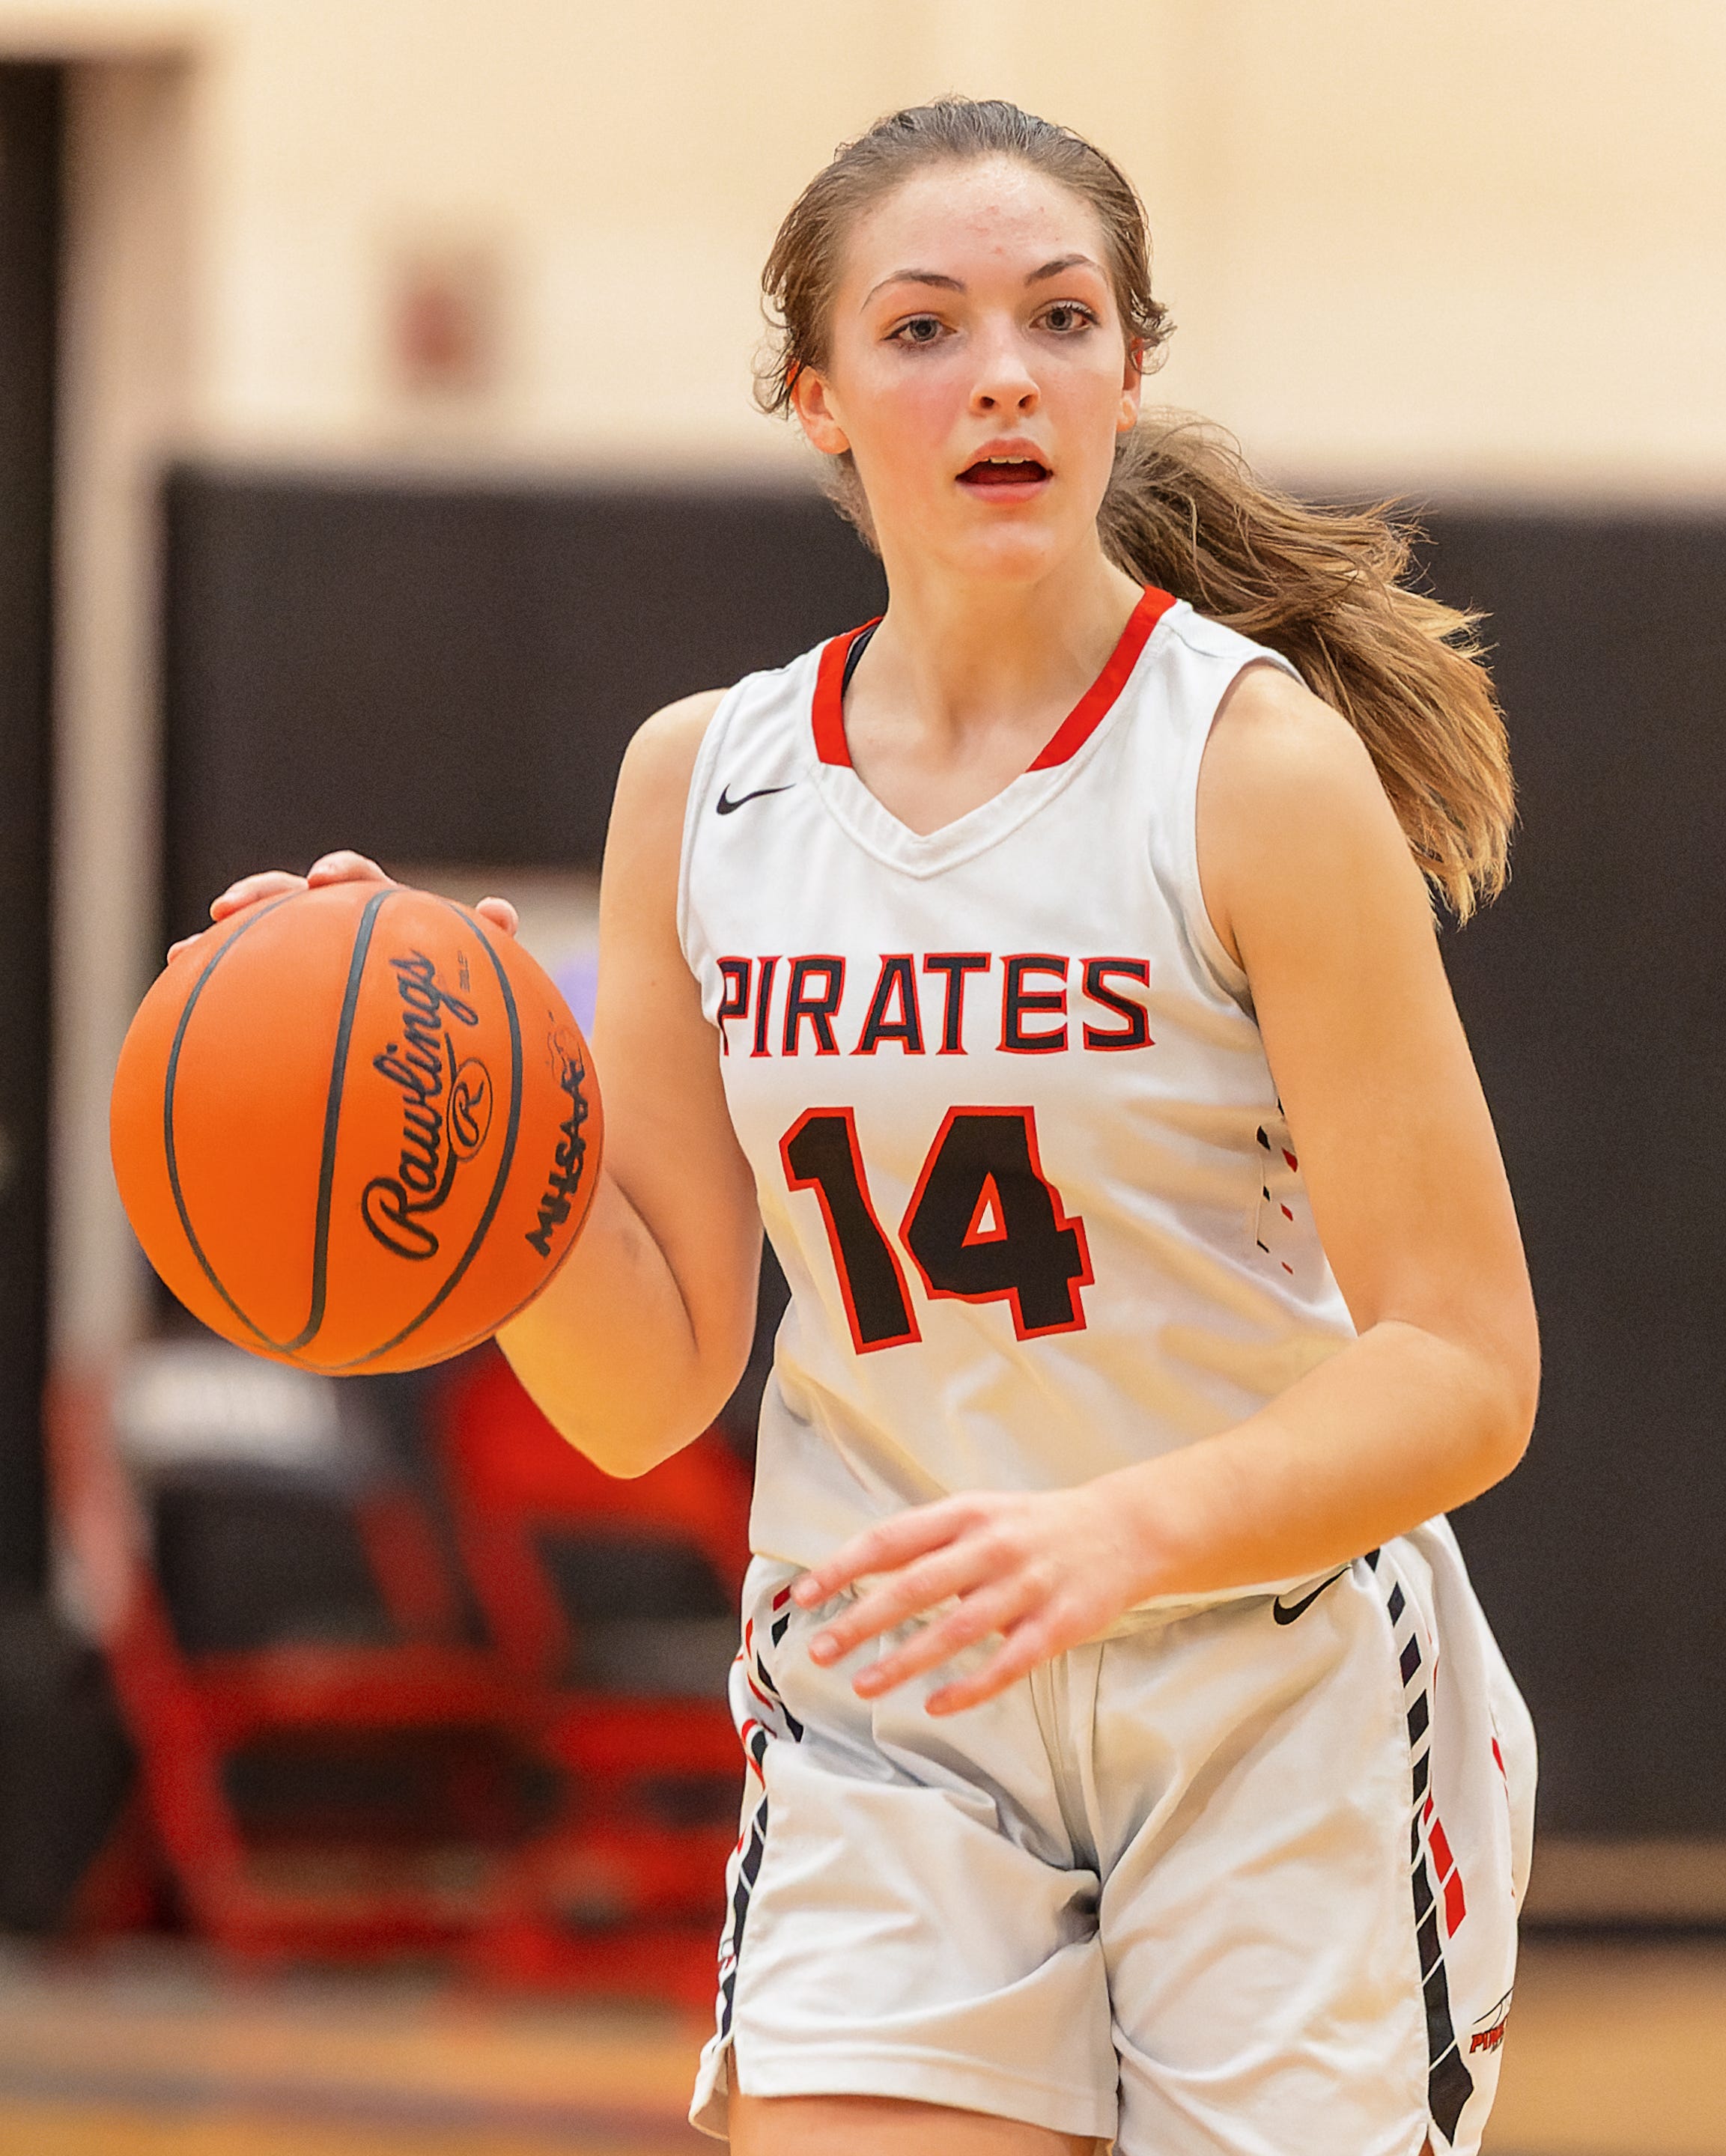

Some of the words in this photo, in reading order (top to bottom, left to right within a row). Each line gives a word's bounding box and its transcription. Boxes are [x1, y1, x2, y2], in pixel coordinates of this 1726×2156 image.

[361, 949, 479, 1261] Rawlings
[717, 953, 1155, 1057] PIRATES
[779, 1106, 1095, 1355] 14
